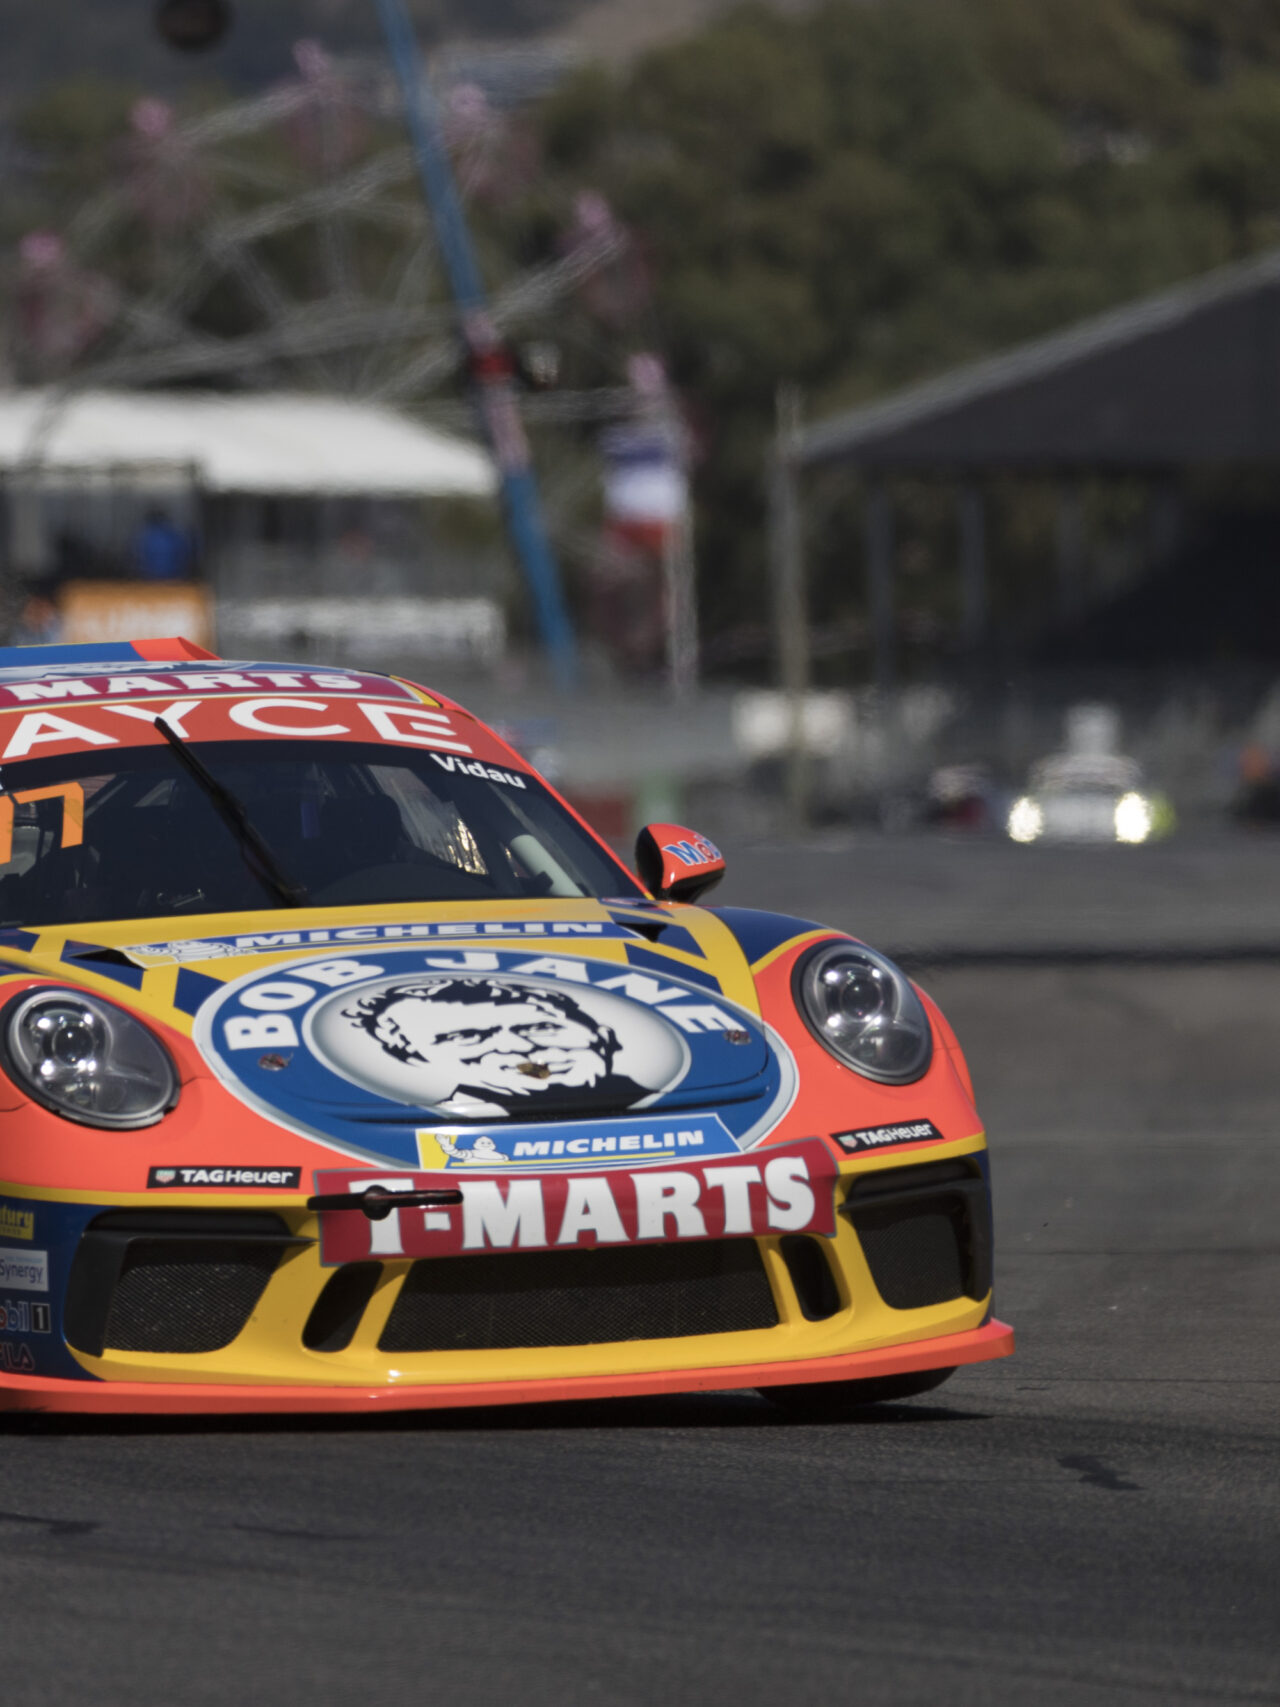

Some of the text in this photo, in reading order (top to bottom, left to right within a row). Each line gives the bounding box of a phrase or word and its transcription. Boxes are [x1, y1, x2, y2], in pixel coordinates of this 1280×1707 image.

[430, 752, 526, 789] Vidau
[233, 922, 604, 948] MICHELIN
[224, 950, 725, 1050] BOB JANE
[512, 1128, 706, 1158] MICHELIN
[350, 1157, 818, 1256] T-MARTS
